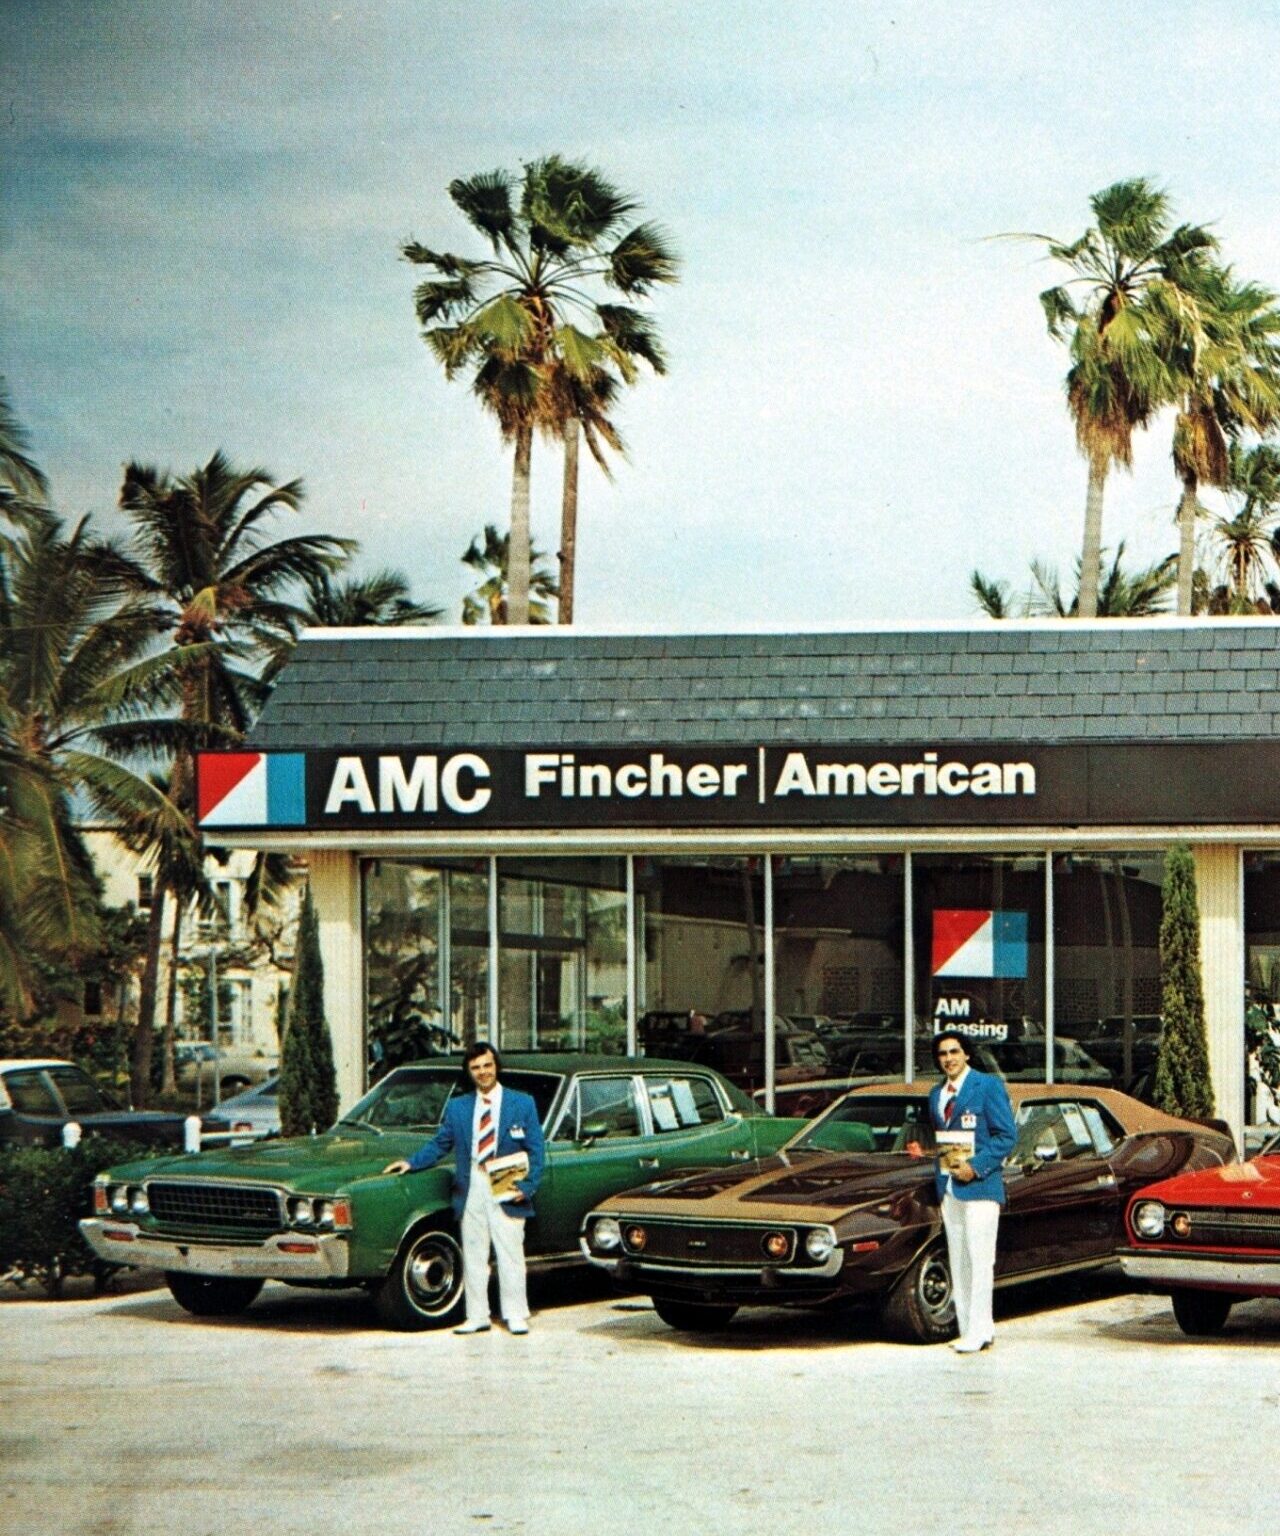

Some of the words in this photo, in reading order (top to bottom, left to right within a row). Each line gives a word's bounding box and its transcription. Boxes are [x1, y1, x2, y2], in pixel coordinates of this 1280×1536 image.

[325, 753, 491, 813] AMC
[525, 754, 747, 797] Fincher
[774, 749, 1036, 797] American
[934, 998, 970, 1016] AM
